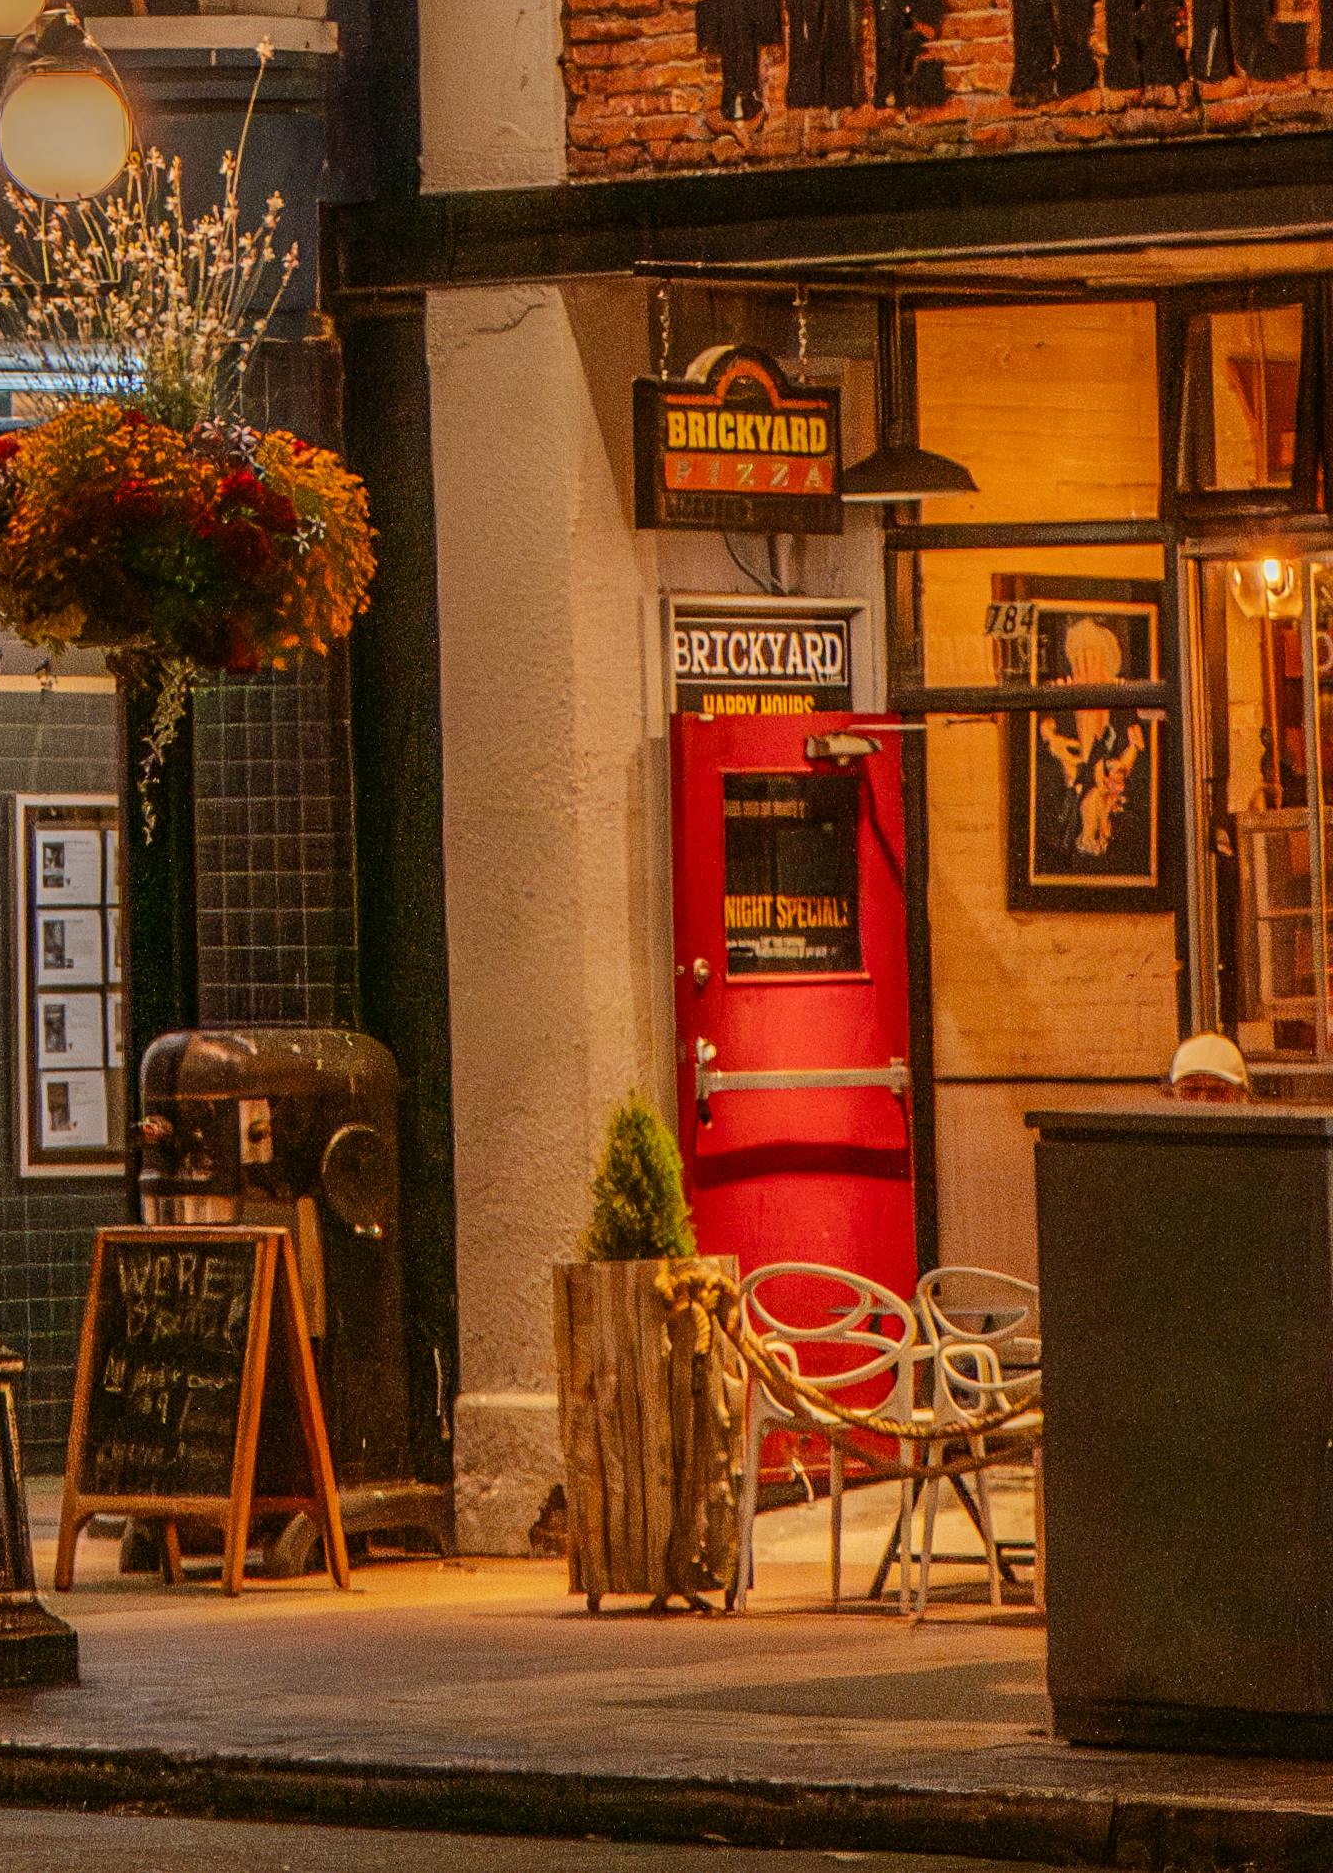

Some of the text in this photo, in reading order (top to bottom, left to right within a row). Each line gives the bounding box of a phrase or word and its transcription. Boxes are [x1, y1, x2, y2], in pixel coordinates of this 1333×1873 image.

[666, 411, 827, 454] BRICKYARD
[676, 459, 825, 488] PIZZA
[986, 604, 1034, 634] 784
[675, 631, 843, 676] BRICKYARD
[724, 894, 774, 928] NIGHT
